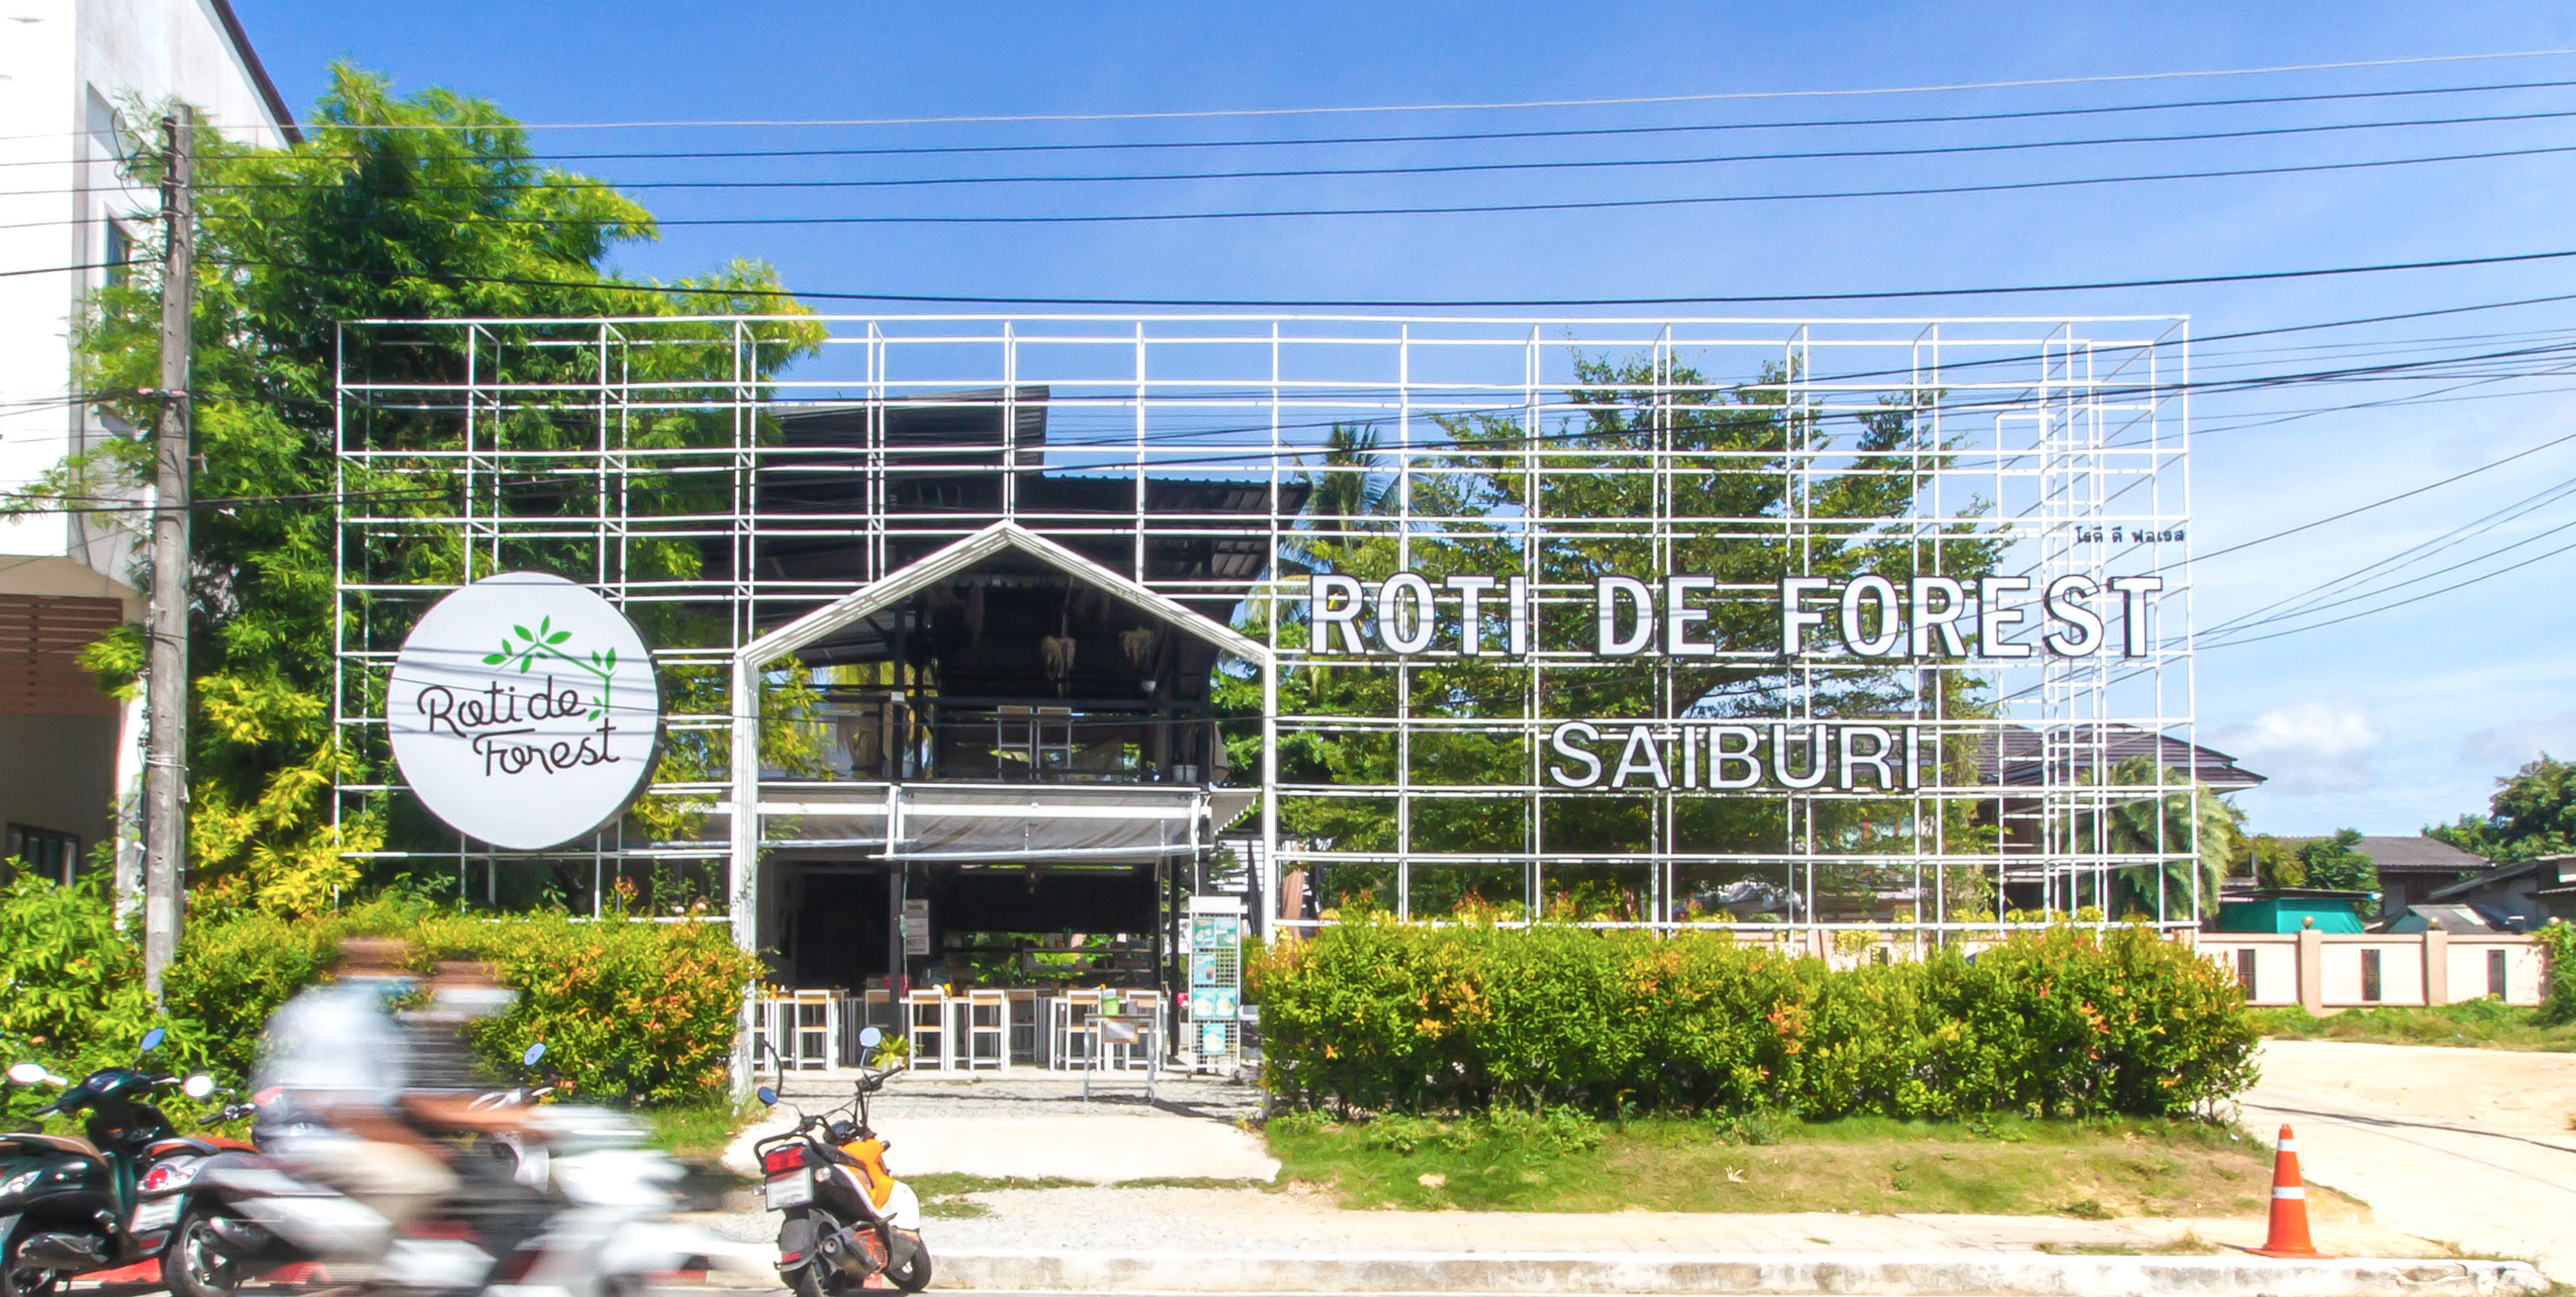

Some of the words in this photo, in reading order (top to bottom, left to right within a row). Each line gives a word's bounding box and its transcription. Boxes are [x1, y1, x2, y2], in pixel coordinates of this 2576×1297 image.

[1310, 572, 1527, 655] ROTI
[1596, 574, 1716, 657] DE
[1779, 574, 2164, 659] FOREST
[418, 681, 523, 738] Roti
[528, 675, 587, 720] de
[472, 717, 620, 777] Forest
[1549, 720, 1921, 790] SAIBURI
